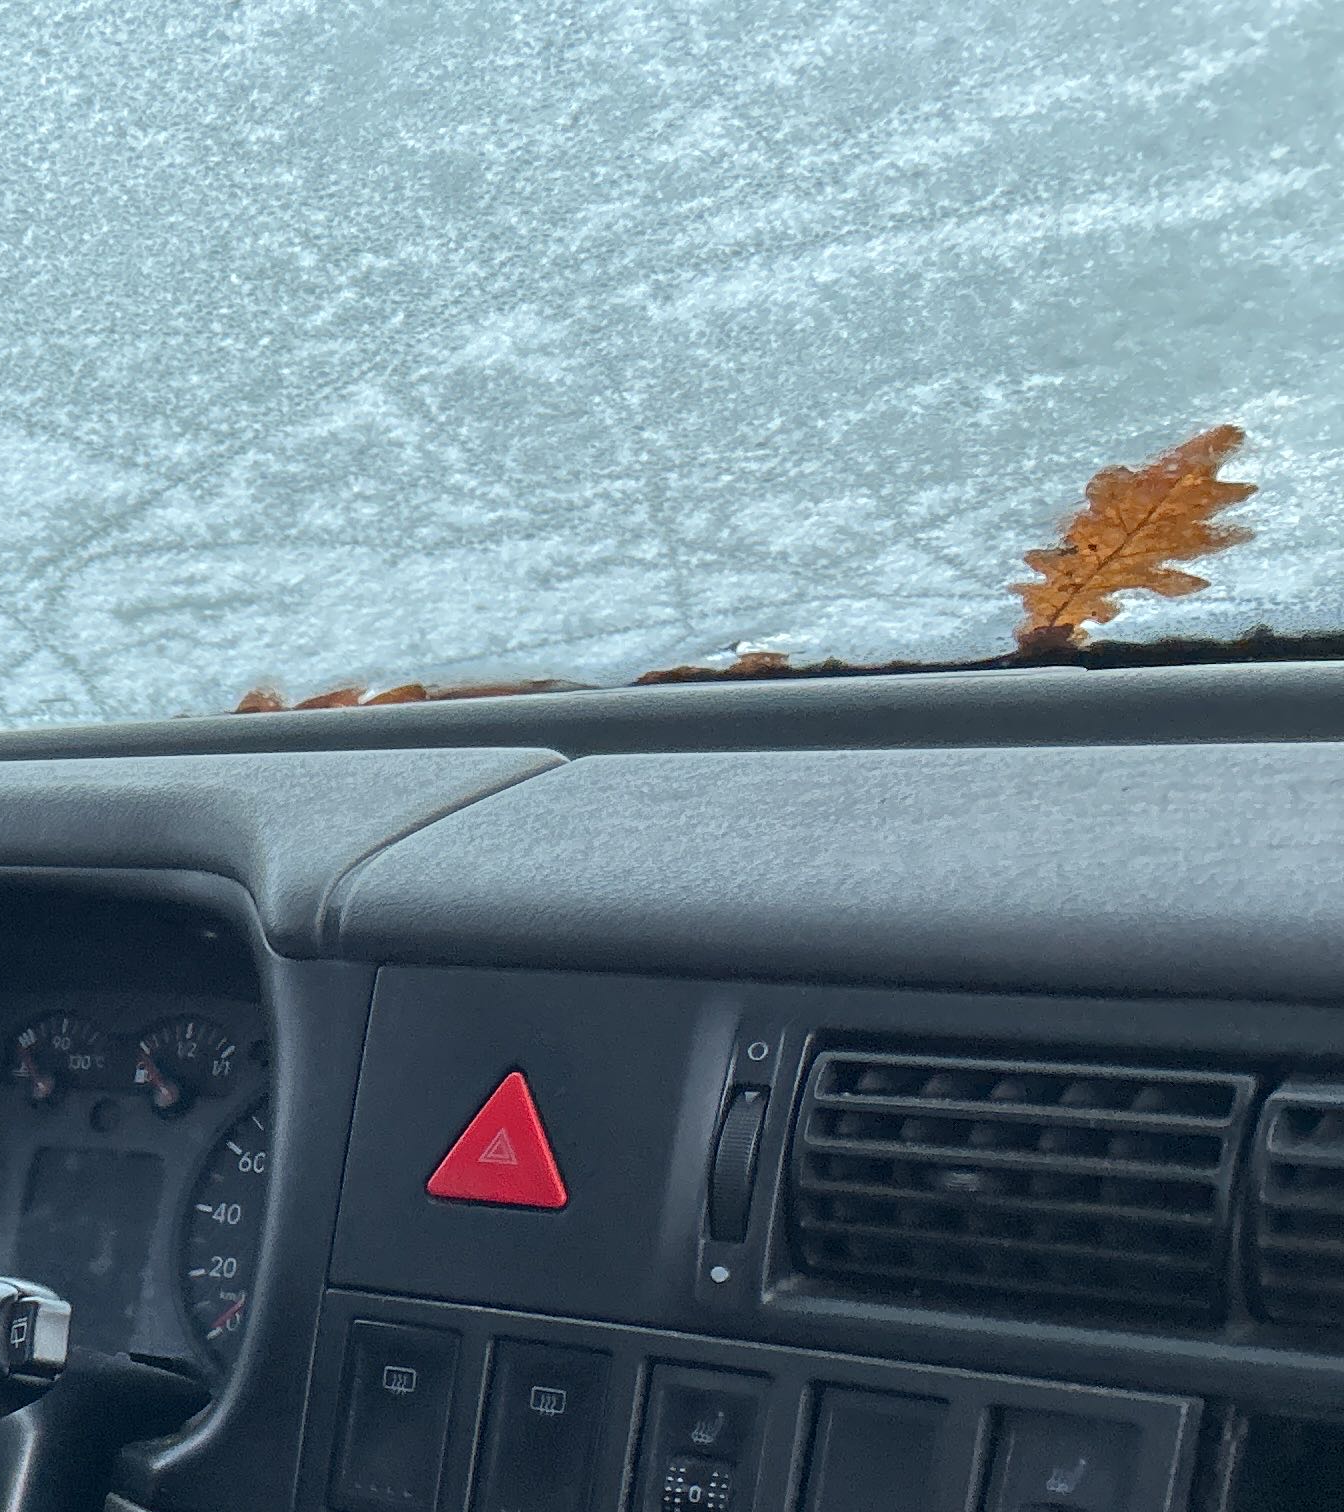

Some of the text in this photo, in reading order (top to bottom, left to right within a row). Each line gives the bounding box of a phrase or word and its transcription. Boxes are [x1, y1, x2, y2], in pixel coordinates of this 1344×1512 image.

[239, 1152, 266, 1173] 60
[212, 1203, 241, 1224] 40
[209, 1255, 237, 1278] 20
